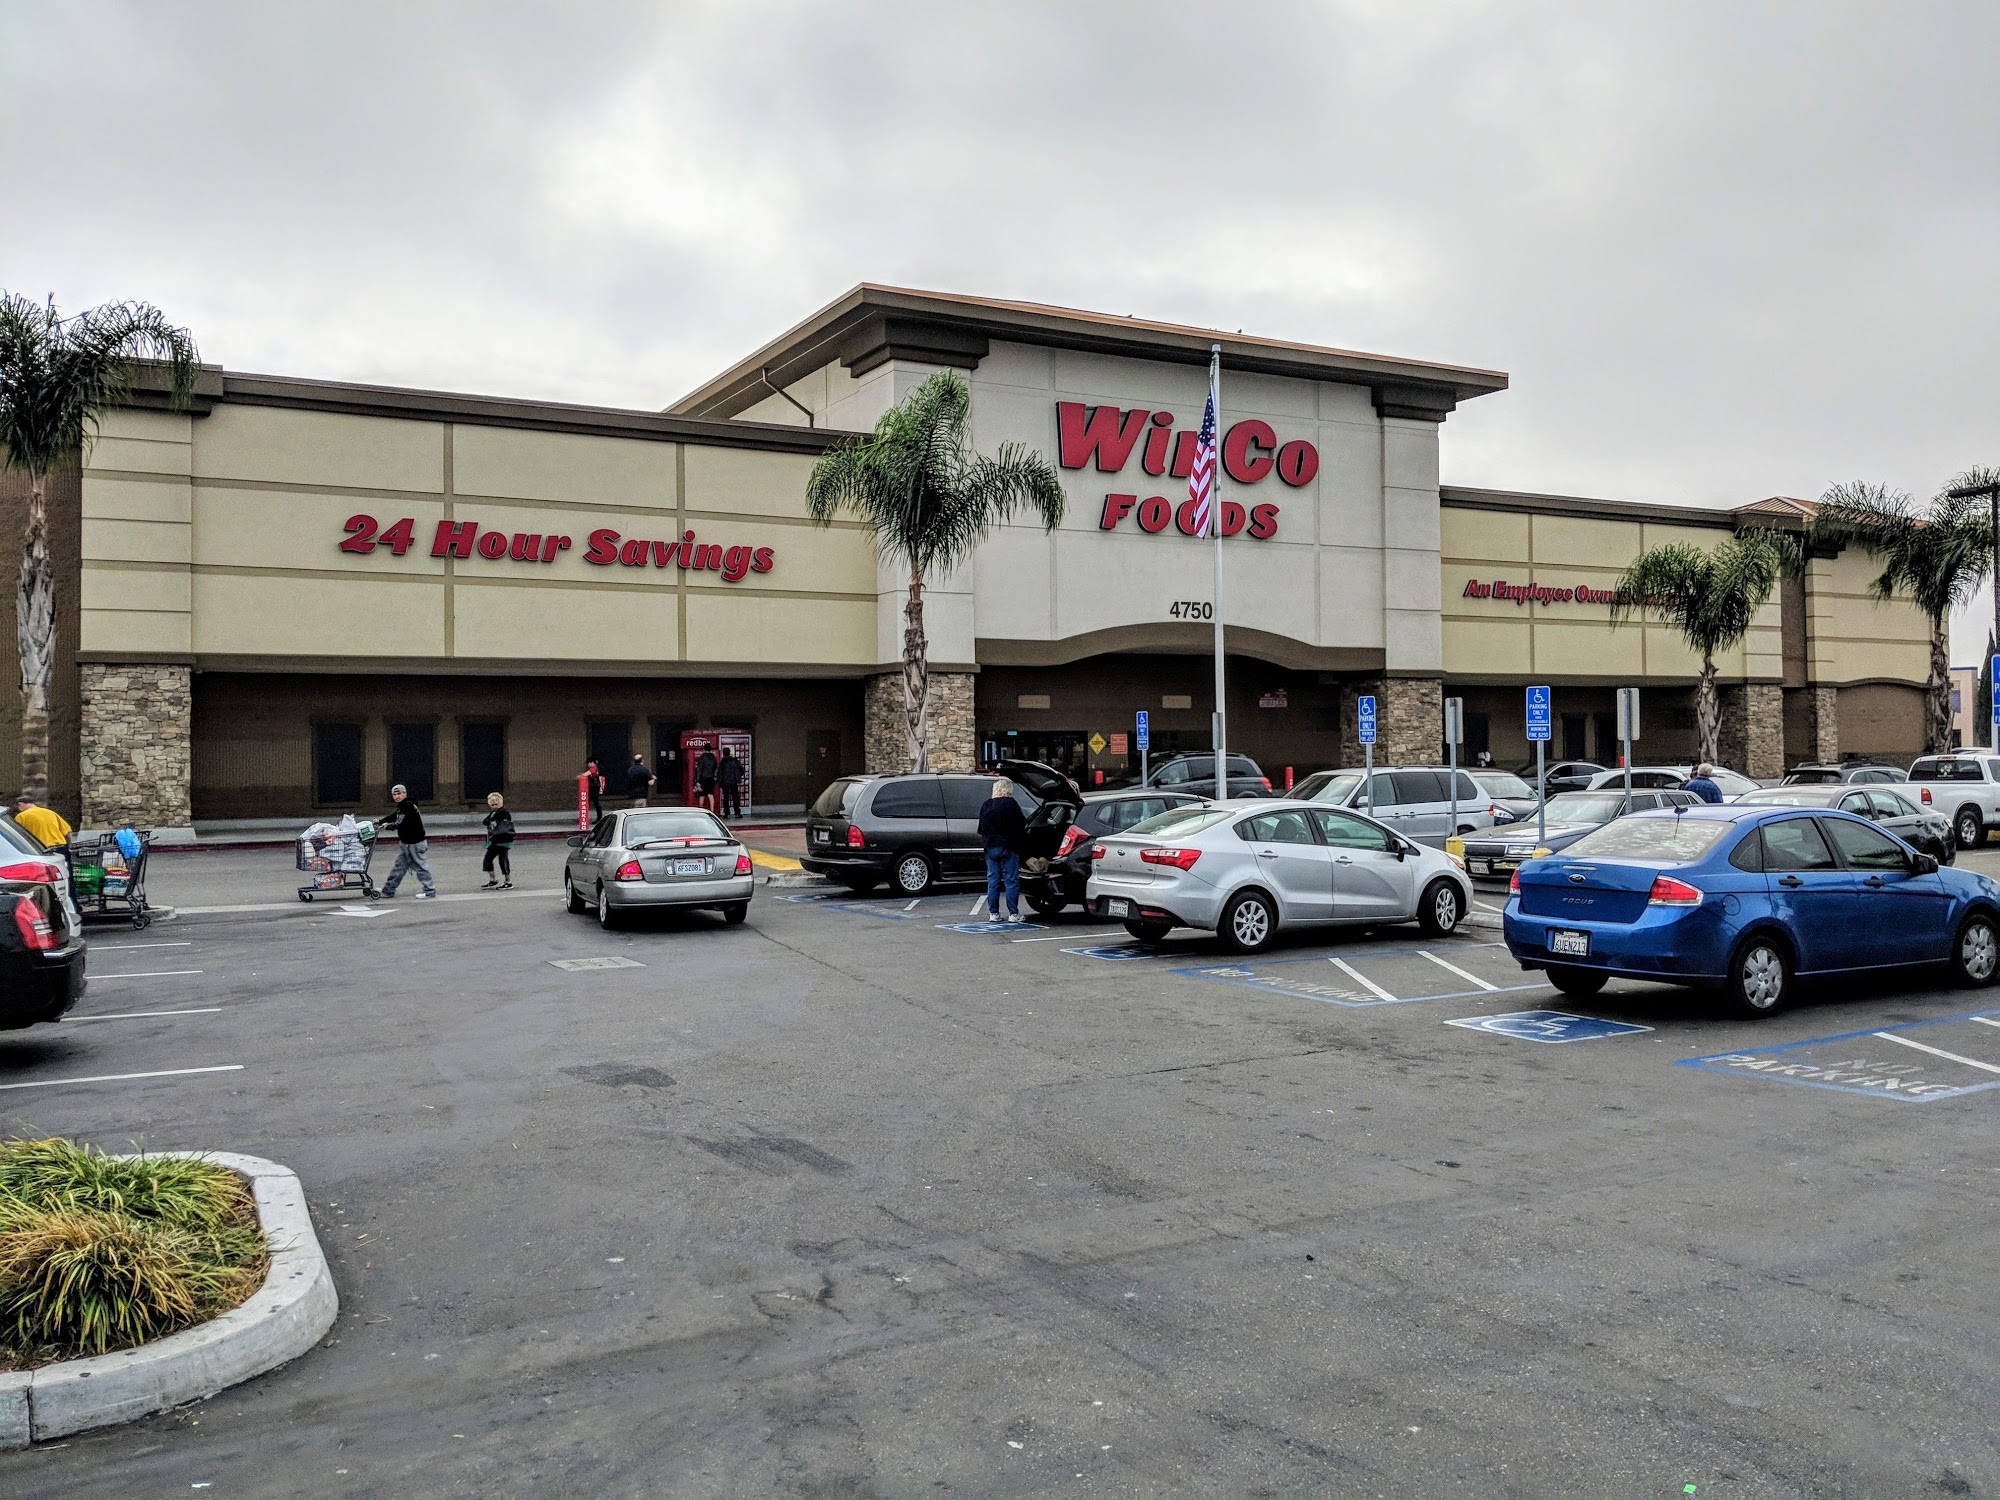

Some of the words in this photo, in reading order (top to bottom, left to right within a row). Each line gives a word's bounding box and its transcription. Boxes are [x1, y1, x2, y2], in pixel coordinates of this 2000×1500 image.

[1100, 493, 1280, 539] FOODS
[339, 514, 415, 555] 24
[429, 520, 571, 563] Hour
[583, 528, 776, 582] Savings
[1463, 579, 1491, 598] An
[1493, 580, 1573, 606] Employee
[1575, 584, 1632, 605] Own
[1170, 601, 1213, 619] 4750
[581, 792, 587, 801] NO
[1562, 897, 1595, 905] FOCUS
[1554, 940, 1586, 954] 6UEN213
[1700, 1053, 1962, 1096] PARKING
